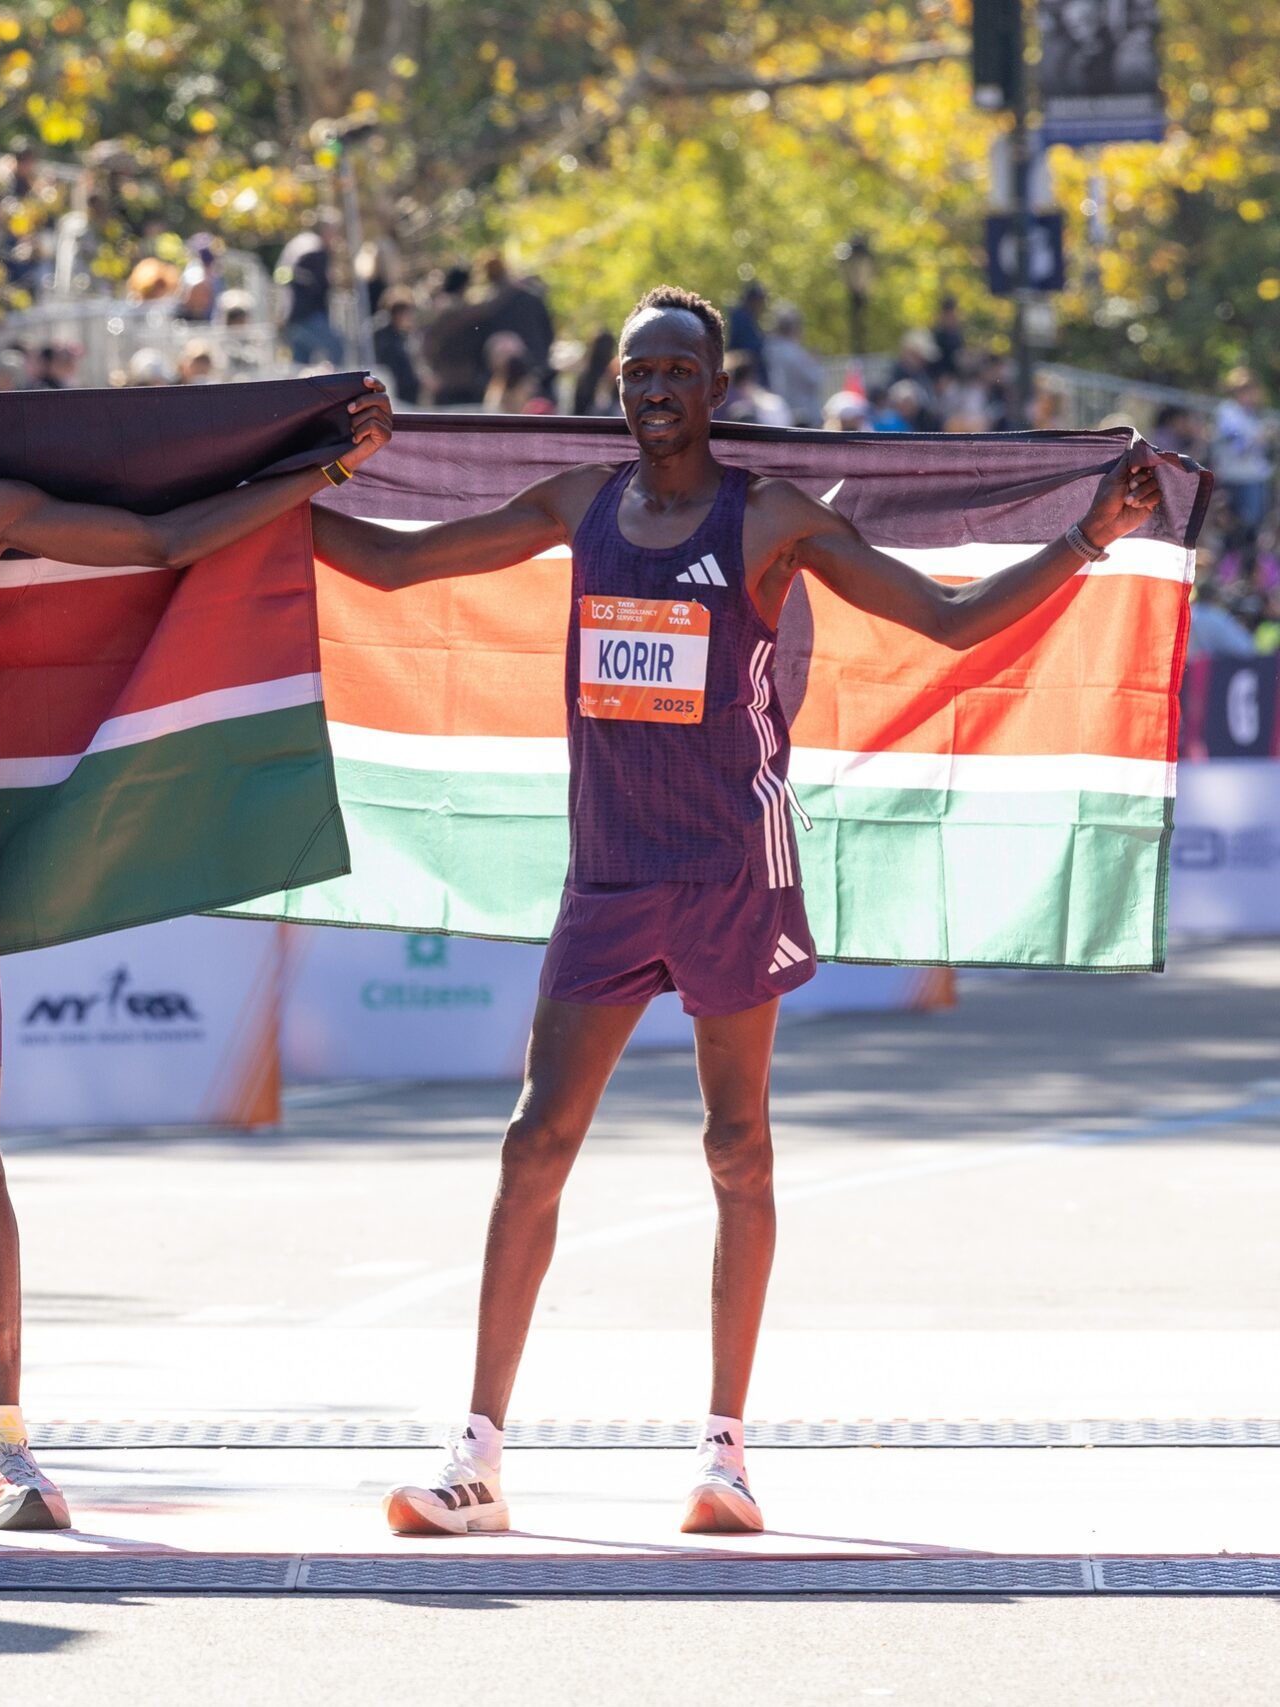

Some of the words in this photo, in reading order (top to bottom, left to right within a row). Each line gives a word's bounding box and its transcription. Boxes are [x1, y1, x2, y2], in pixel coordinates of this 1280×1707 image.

[592, 600, 614, 620] tcs
[617, 608, 657, 616] CONSULTANCY
[616, 614, 642, 622] SERVICES
[668, 617, 691, 625] TATA
[598, 639, 674, 682] KORIR
[653, 698, 695, 713] 2025
